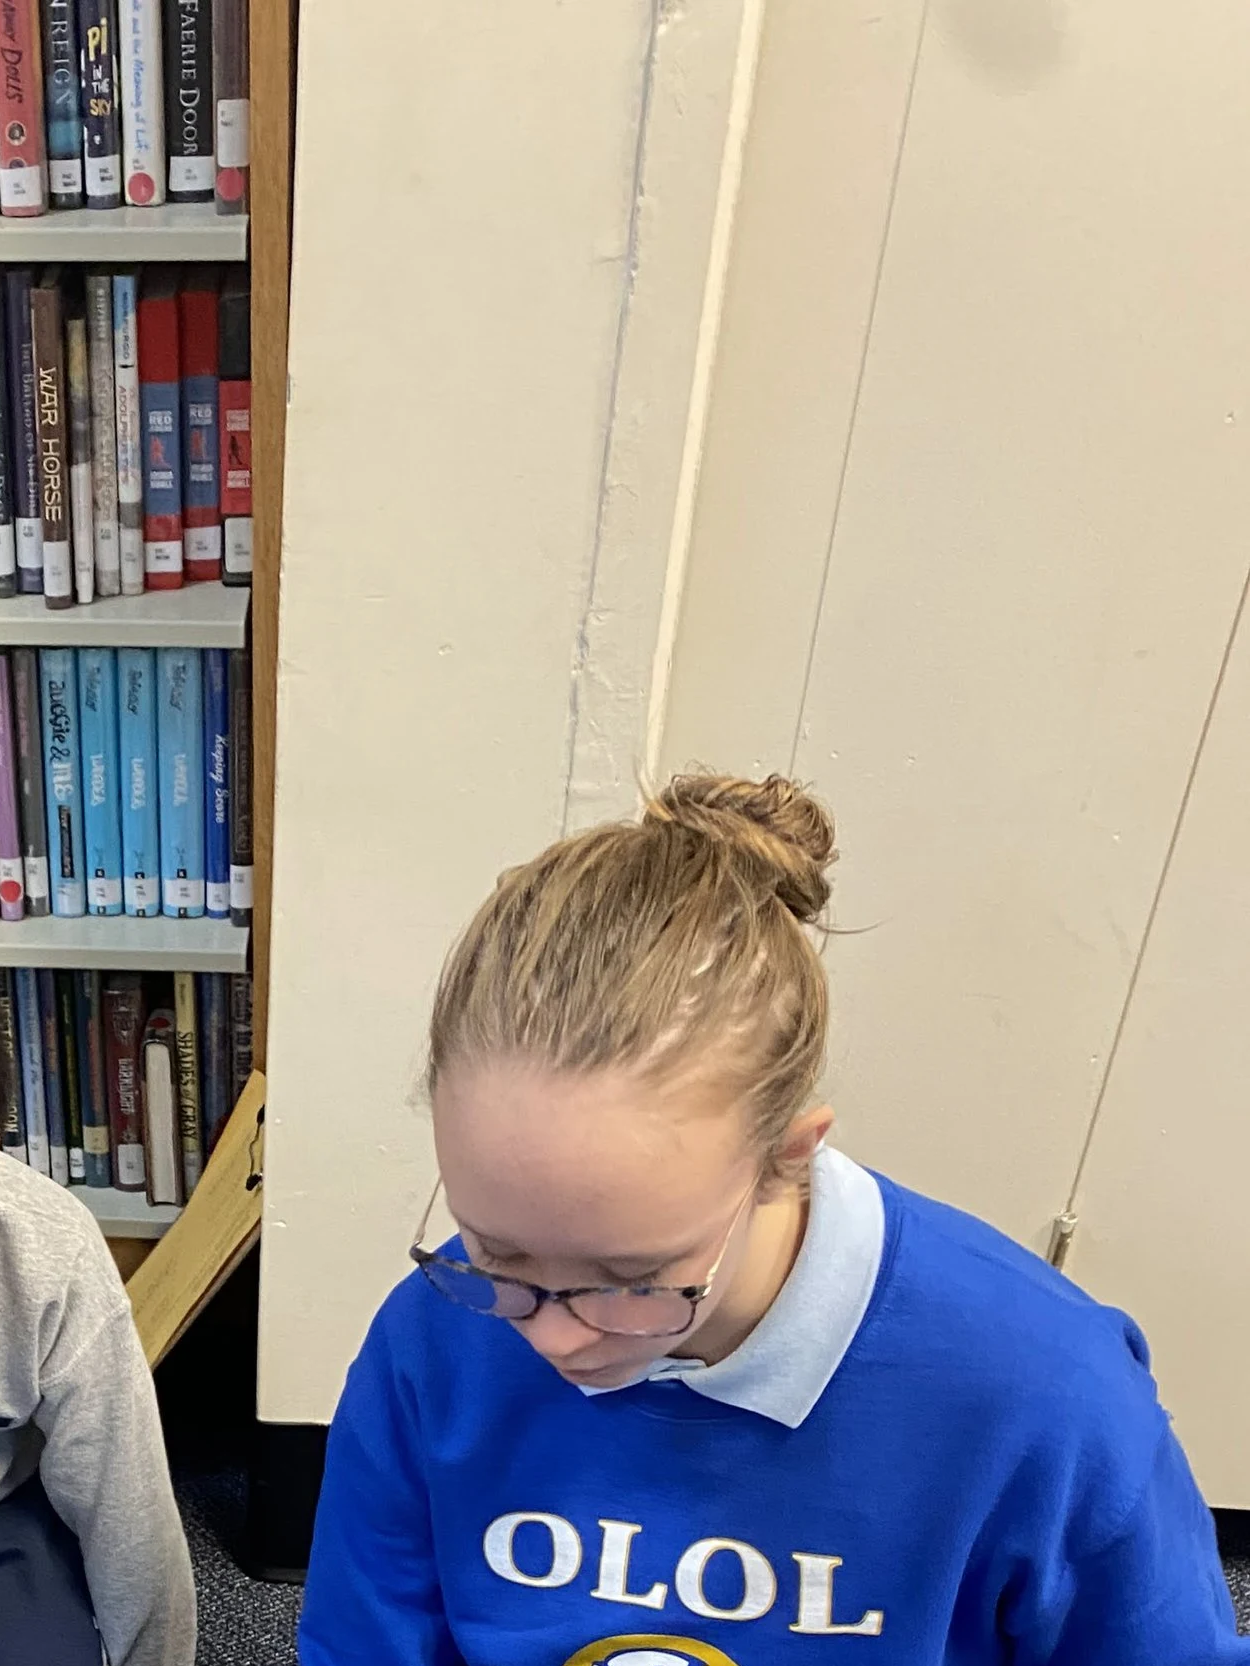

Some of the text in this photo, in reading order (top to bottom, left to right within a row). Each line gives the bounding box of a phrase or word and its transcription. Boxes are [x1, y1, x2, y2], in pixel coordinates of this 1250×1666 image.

[2, 49, 22, 103] DOLLS
[51, 21, 70, 105] REIGN
[92, 64, 103, 81] IN
[92, 80, 110, 94] THE
[178, 0, 200, 155] FAERIE DOOR
[89, 99, 112, 116] SKY
[39, 367, 62, 523] WAR HORSE
[213, 734, 230, 824] Keeping Score
[178, 1031, 195, 1086] SHADES
[180, 1099, 198, 1139] GRAY
[483, 1511, 884, 1636] OLOL
